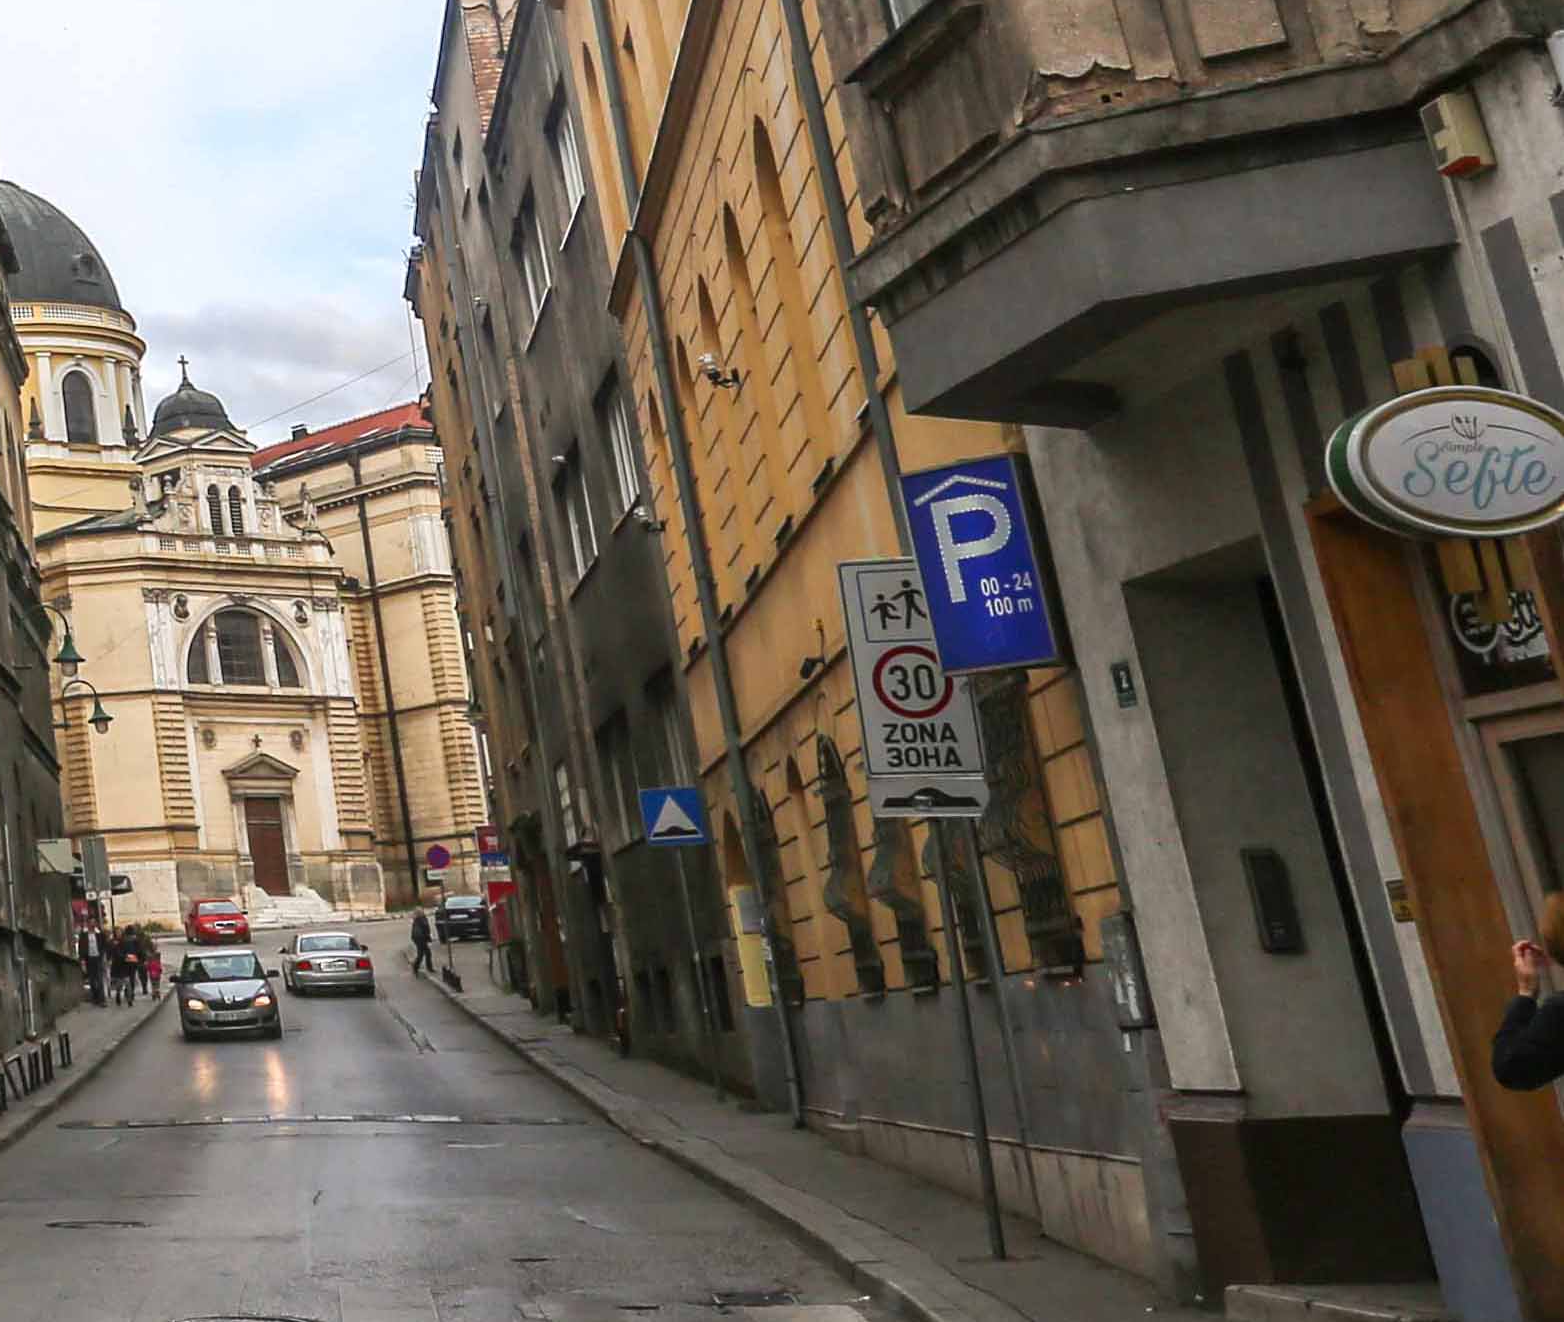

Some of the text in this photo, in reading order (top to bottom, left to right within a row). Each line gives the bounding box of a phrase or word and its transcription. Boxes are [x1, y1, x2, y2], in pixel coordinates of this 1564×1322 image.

[1403, 441, 1557, 510] Sefte
[930, 494, 1011, 603] P
[980, 577, 1001, 597] 00
[1012, 572, 1033, 591] 24
[985, 596, 1034, 617] 100 m
[887, 664, 937, 702] 30
[882, 723, 959, 744] ZONA
[887, 747, 963, 768] ЗОНА
